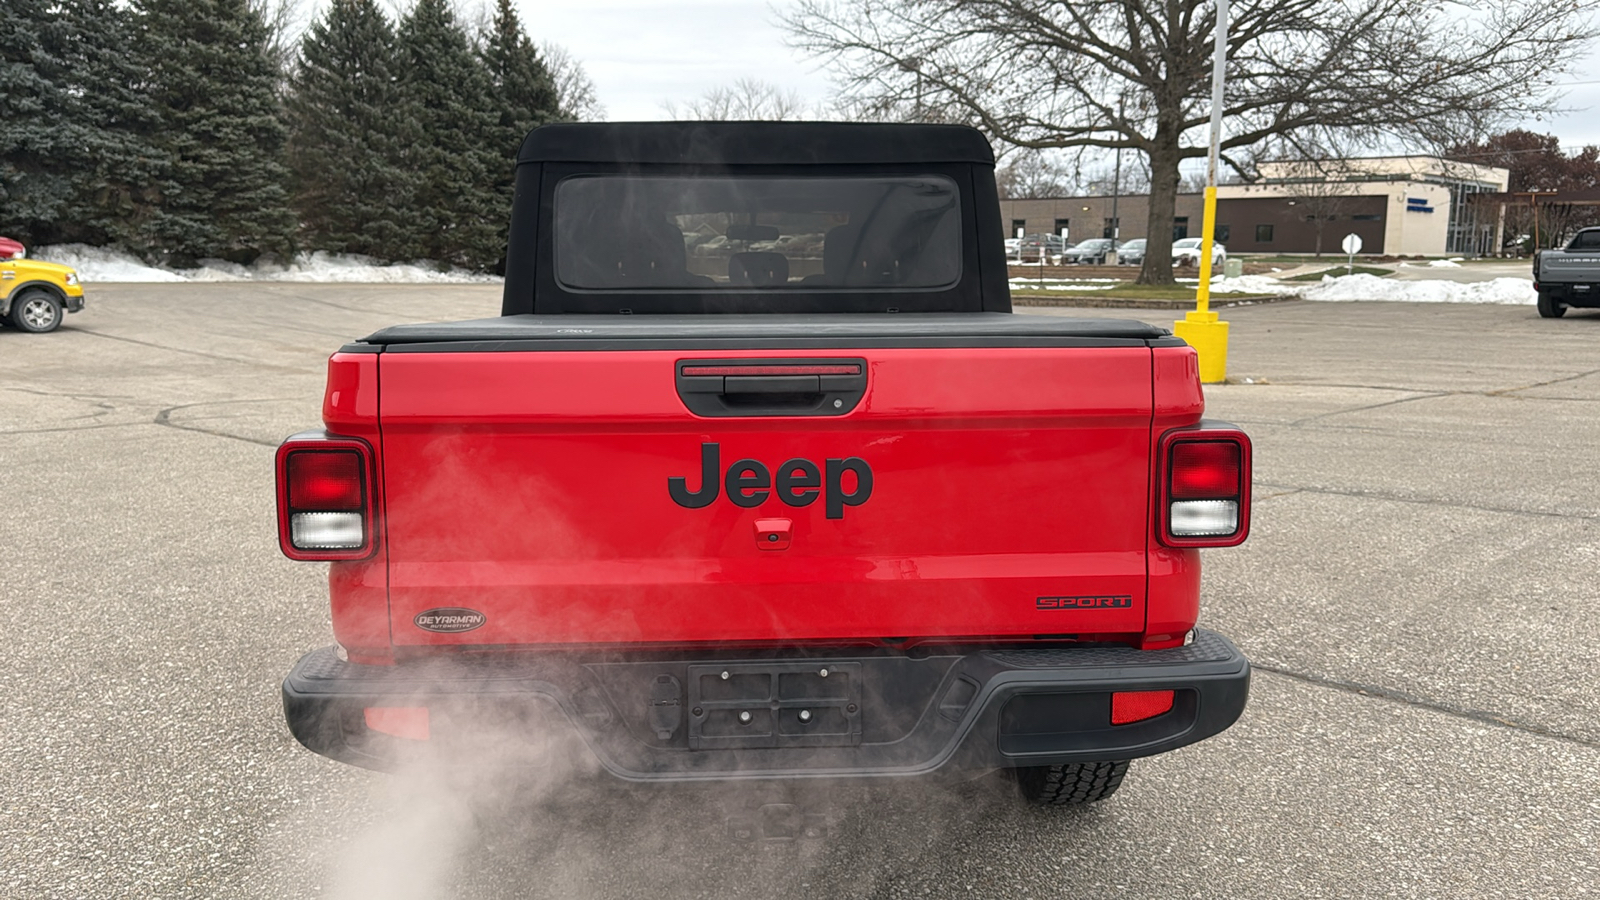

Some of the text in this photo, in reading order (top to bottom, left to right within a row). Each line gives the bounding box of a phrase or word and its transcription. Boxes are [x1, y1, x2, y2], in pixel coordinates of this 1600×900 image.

[667, 442, 874, 520] Jeep
[1036, 595, 1132, 609] SPORT
[418, 615, 482, 625] DEYARMAN
